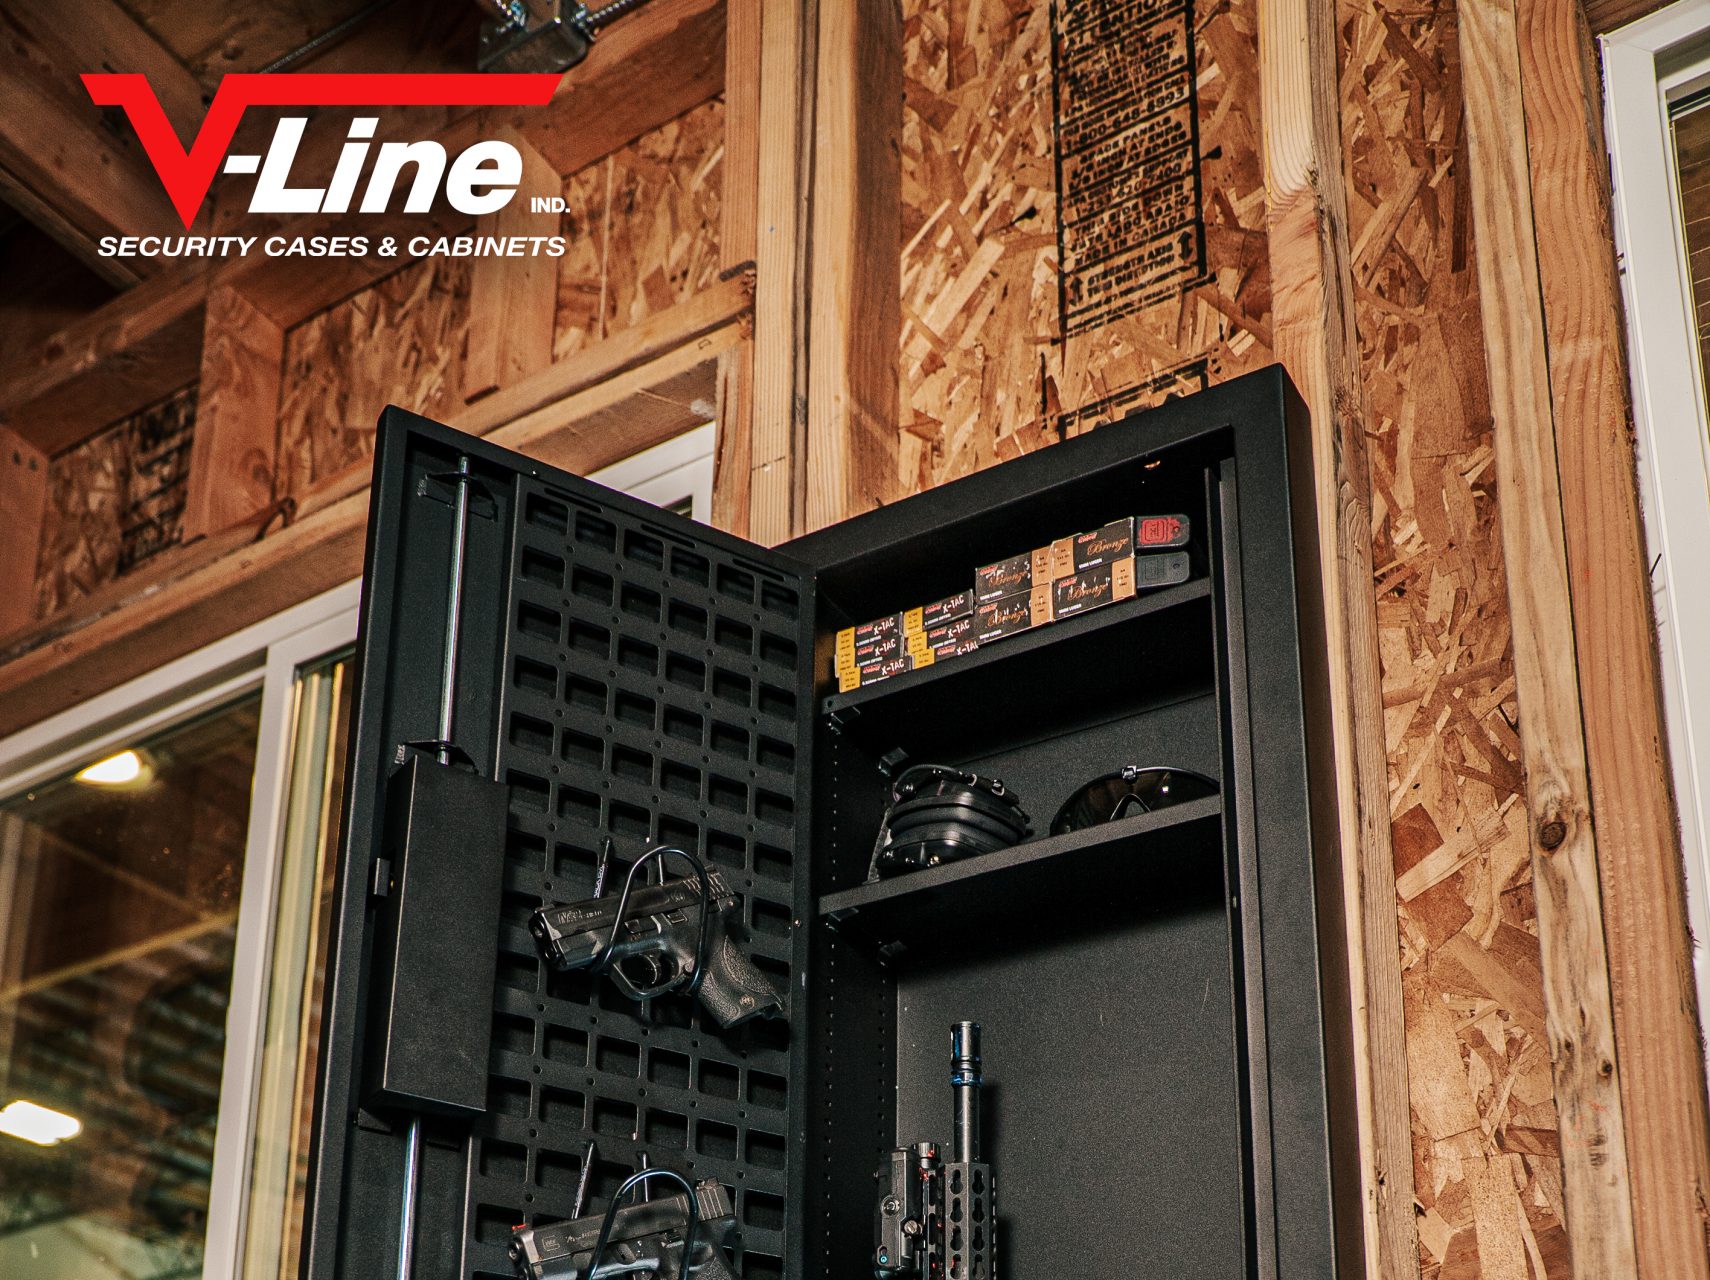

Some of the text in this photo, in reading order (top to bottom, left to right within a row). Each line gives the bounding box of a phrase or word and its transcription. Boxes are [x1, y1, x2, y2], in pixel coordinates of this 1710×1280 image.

[1069, 0, 1160, 46] ATTENTIO
[1087, 537, 1129, 556] Bronze
[942, 595, 965, 614] X-TAC
[873, 617, 895, 636] X-TAC
[947, 620, 971, 639] X-TAC
[875, 638, 897, 657] X-TAC
[881, 659, 905, 676] X-TAC
